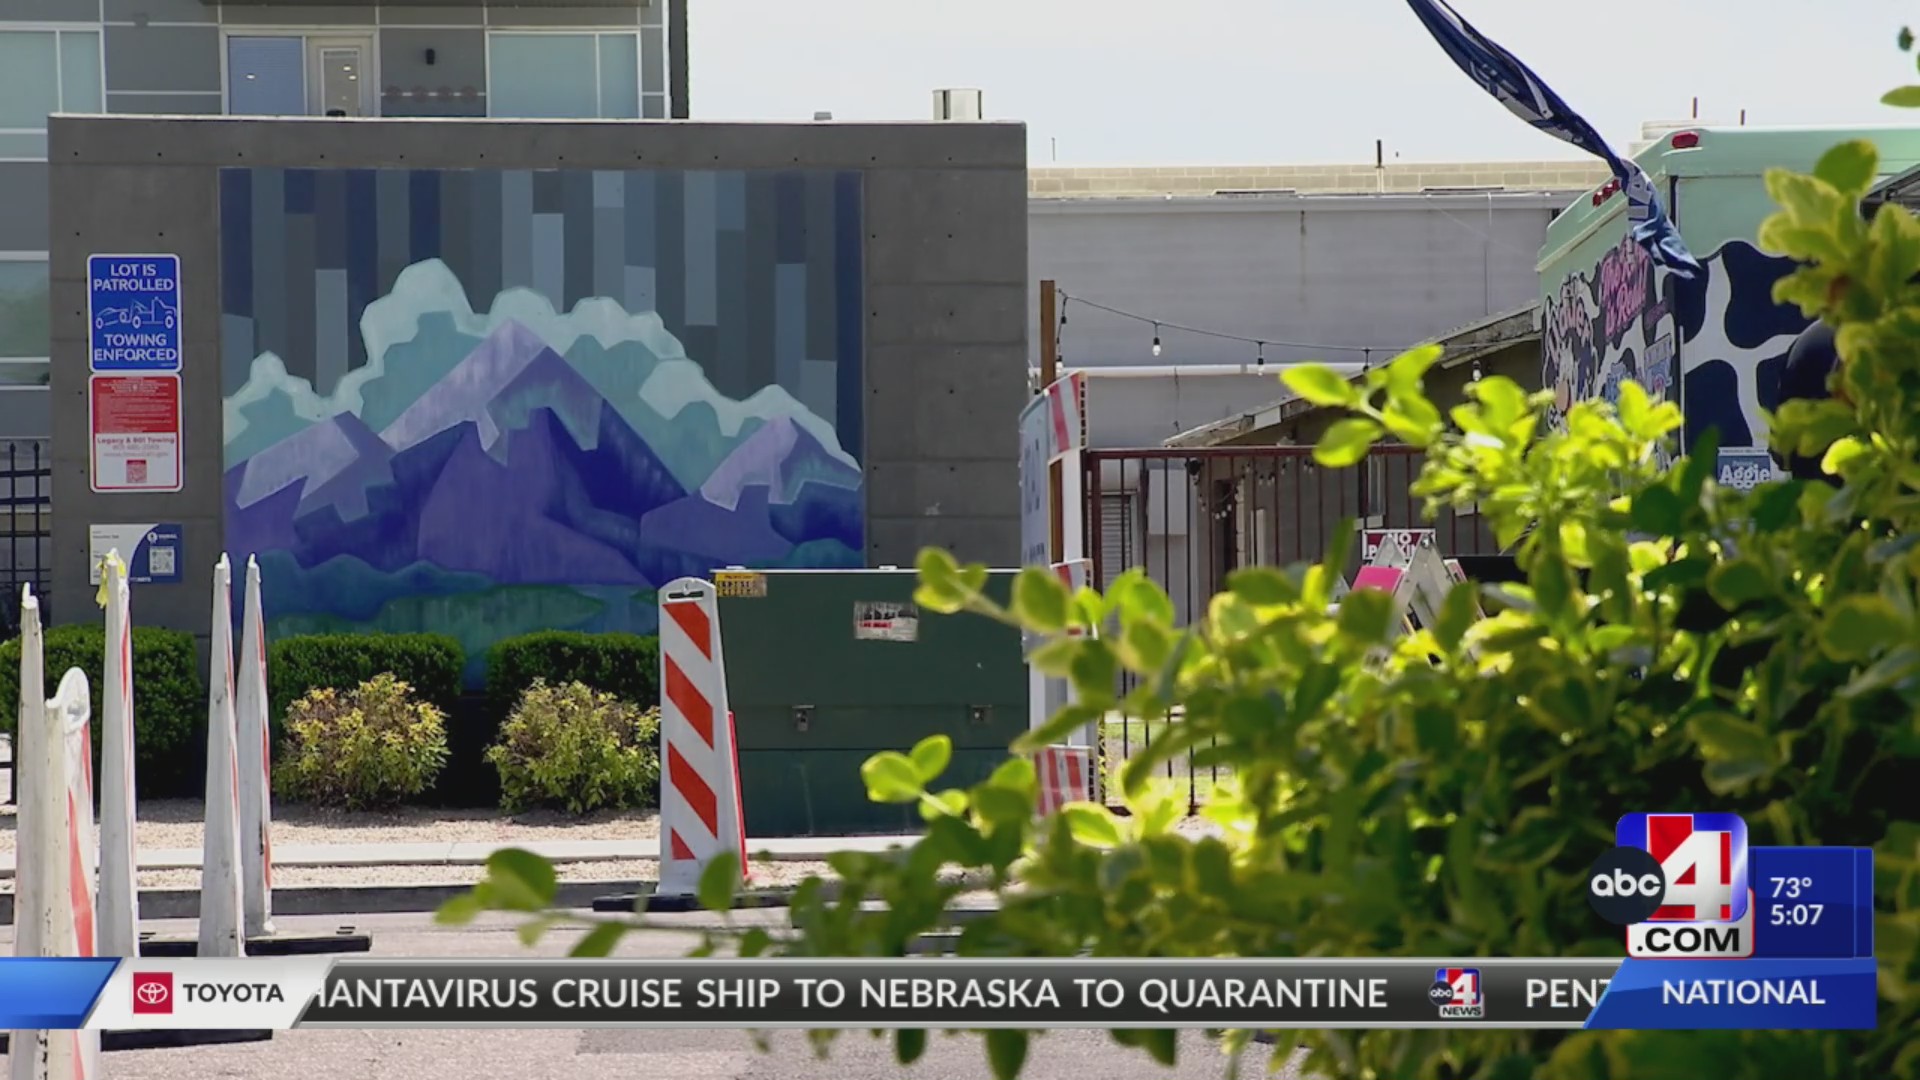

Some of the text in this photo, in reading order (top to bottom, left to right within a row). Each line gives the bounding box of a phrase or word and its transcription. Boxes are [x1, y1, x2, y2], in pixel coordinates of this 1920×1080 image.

[110, 264, 157, 277] LOT IS
[93, 279, 174, 291] PATROLLED
[103, 333, 167, 347] TOWING
[93, 348, 177, 361] ENFORCED
[97, 437, 124, 445] Legacy
[148, 437, 175, 445] Towing
[1719, 464, 1770, 490] Aggie
